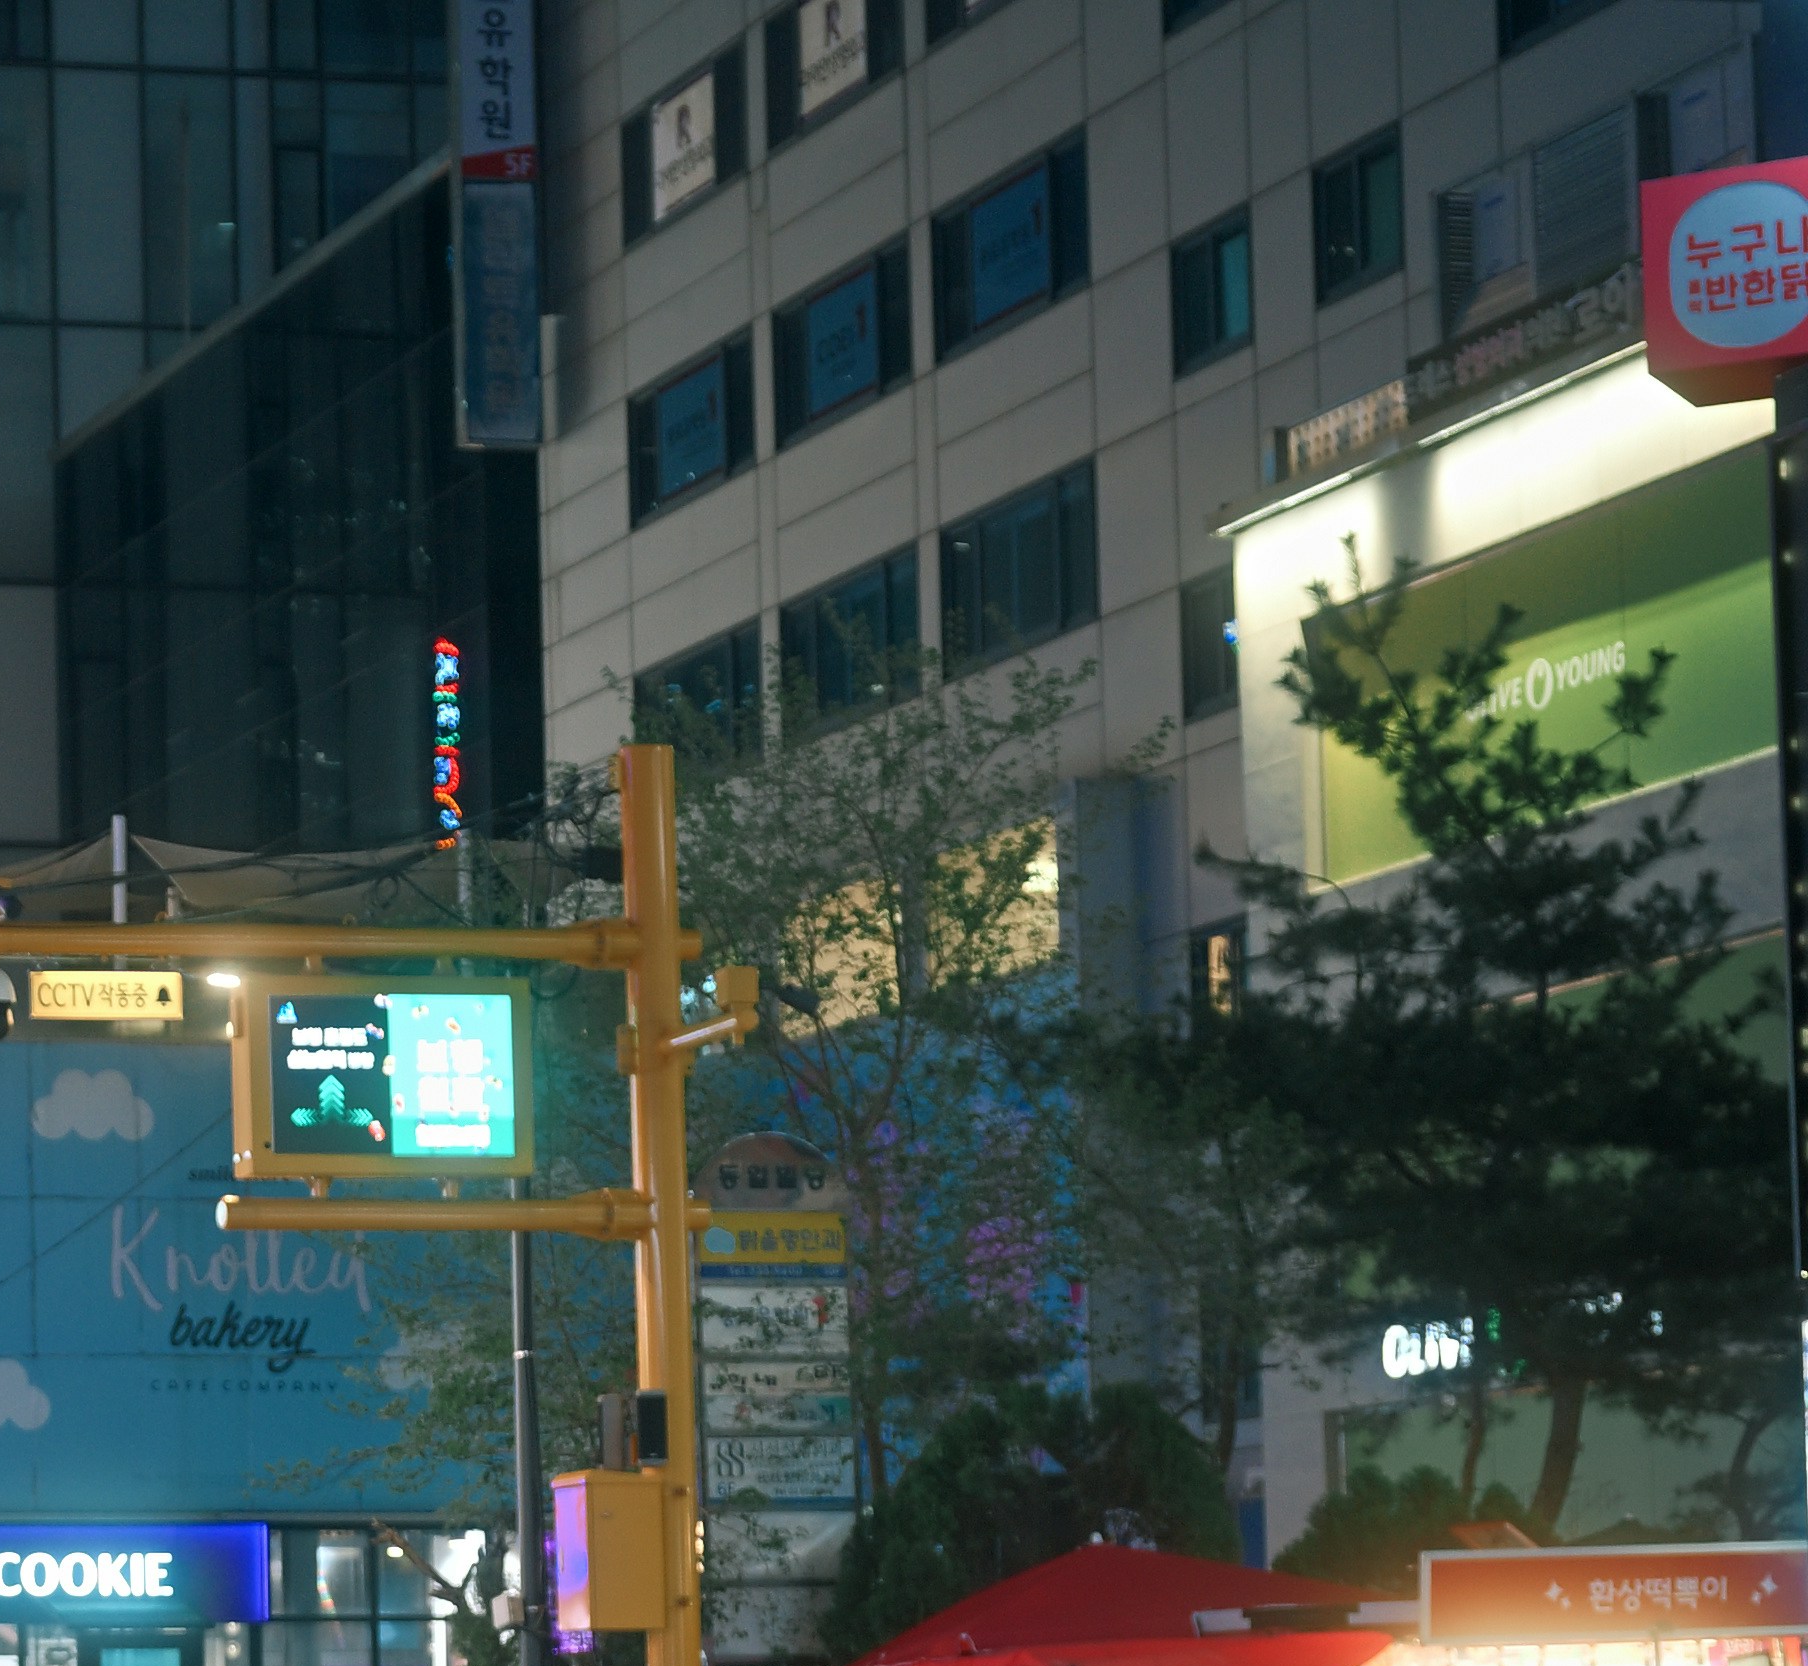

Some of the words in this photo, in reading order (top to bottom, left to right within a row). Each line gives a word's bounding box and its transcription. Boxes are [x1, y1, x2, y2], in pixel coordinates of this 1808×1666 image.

[1555, 640, 1626, 691] YOUNG
[38, 983, 95, 1007] CCTV
[98, 983, 149, 1007] 작동중
[170, 1301, 316, 1373] bakery
[150, 1379, 209, 1392] CAFE
[223, 1378, 339, 1393] COMPANY
